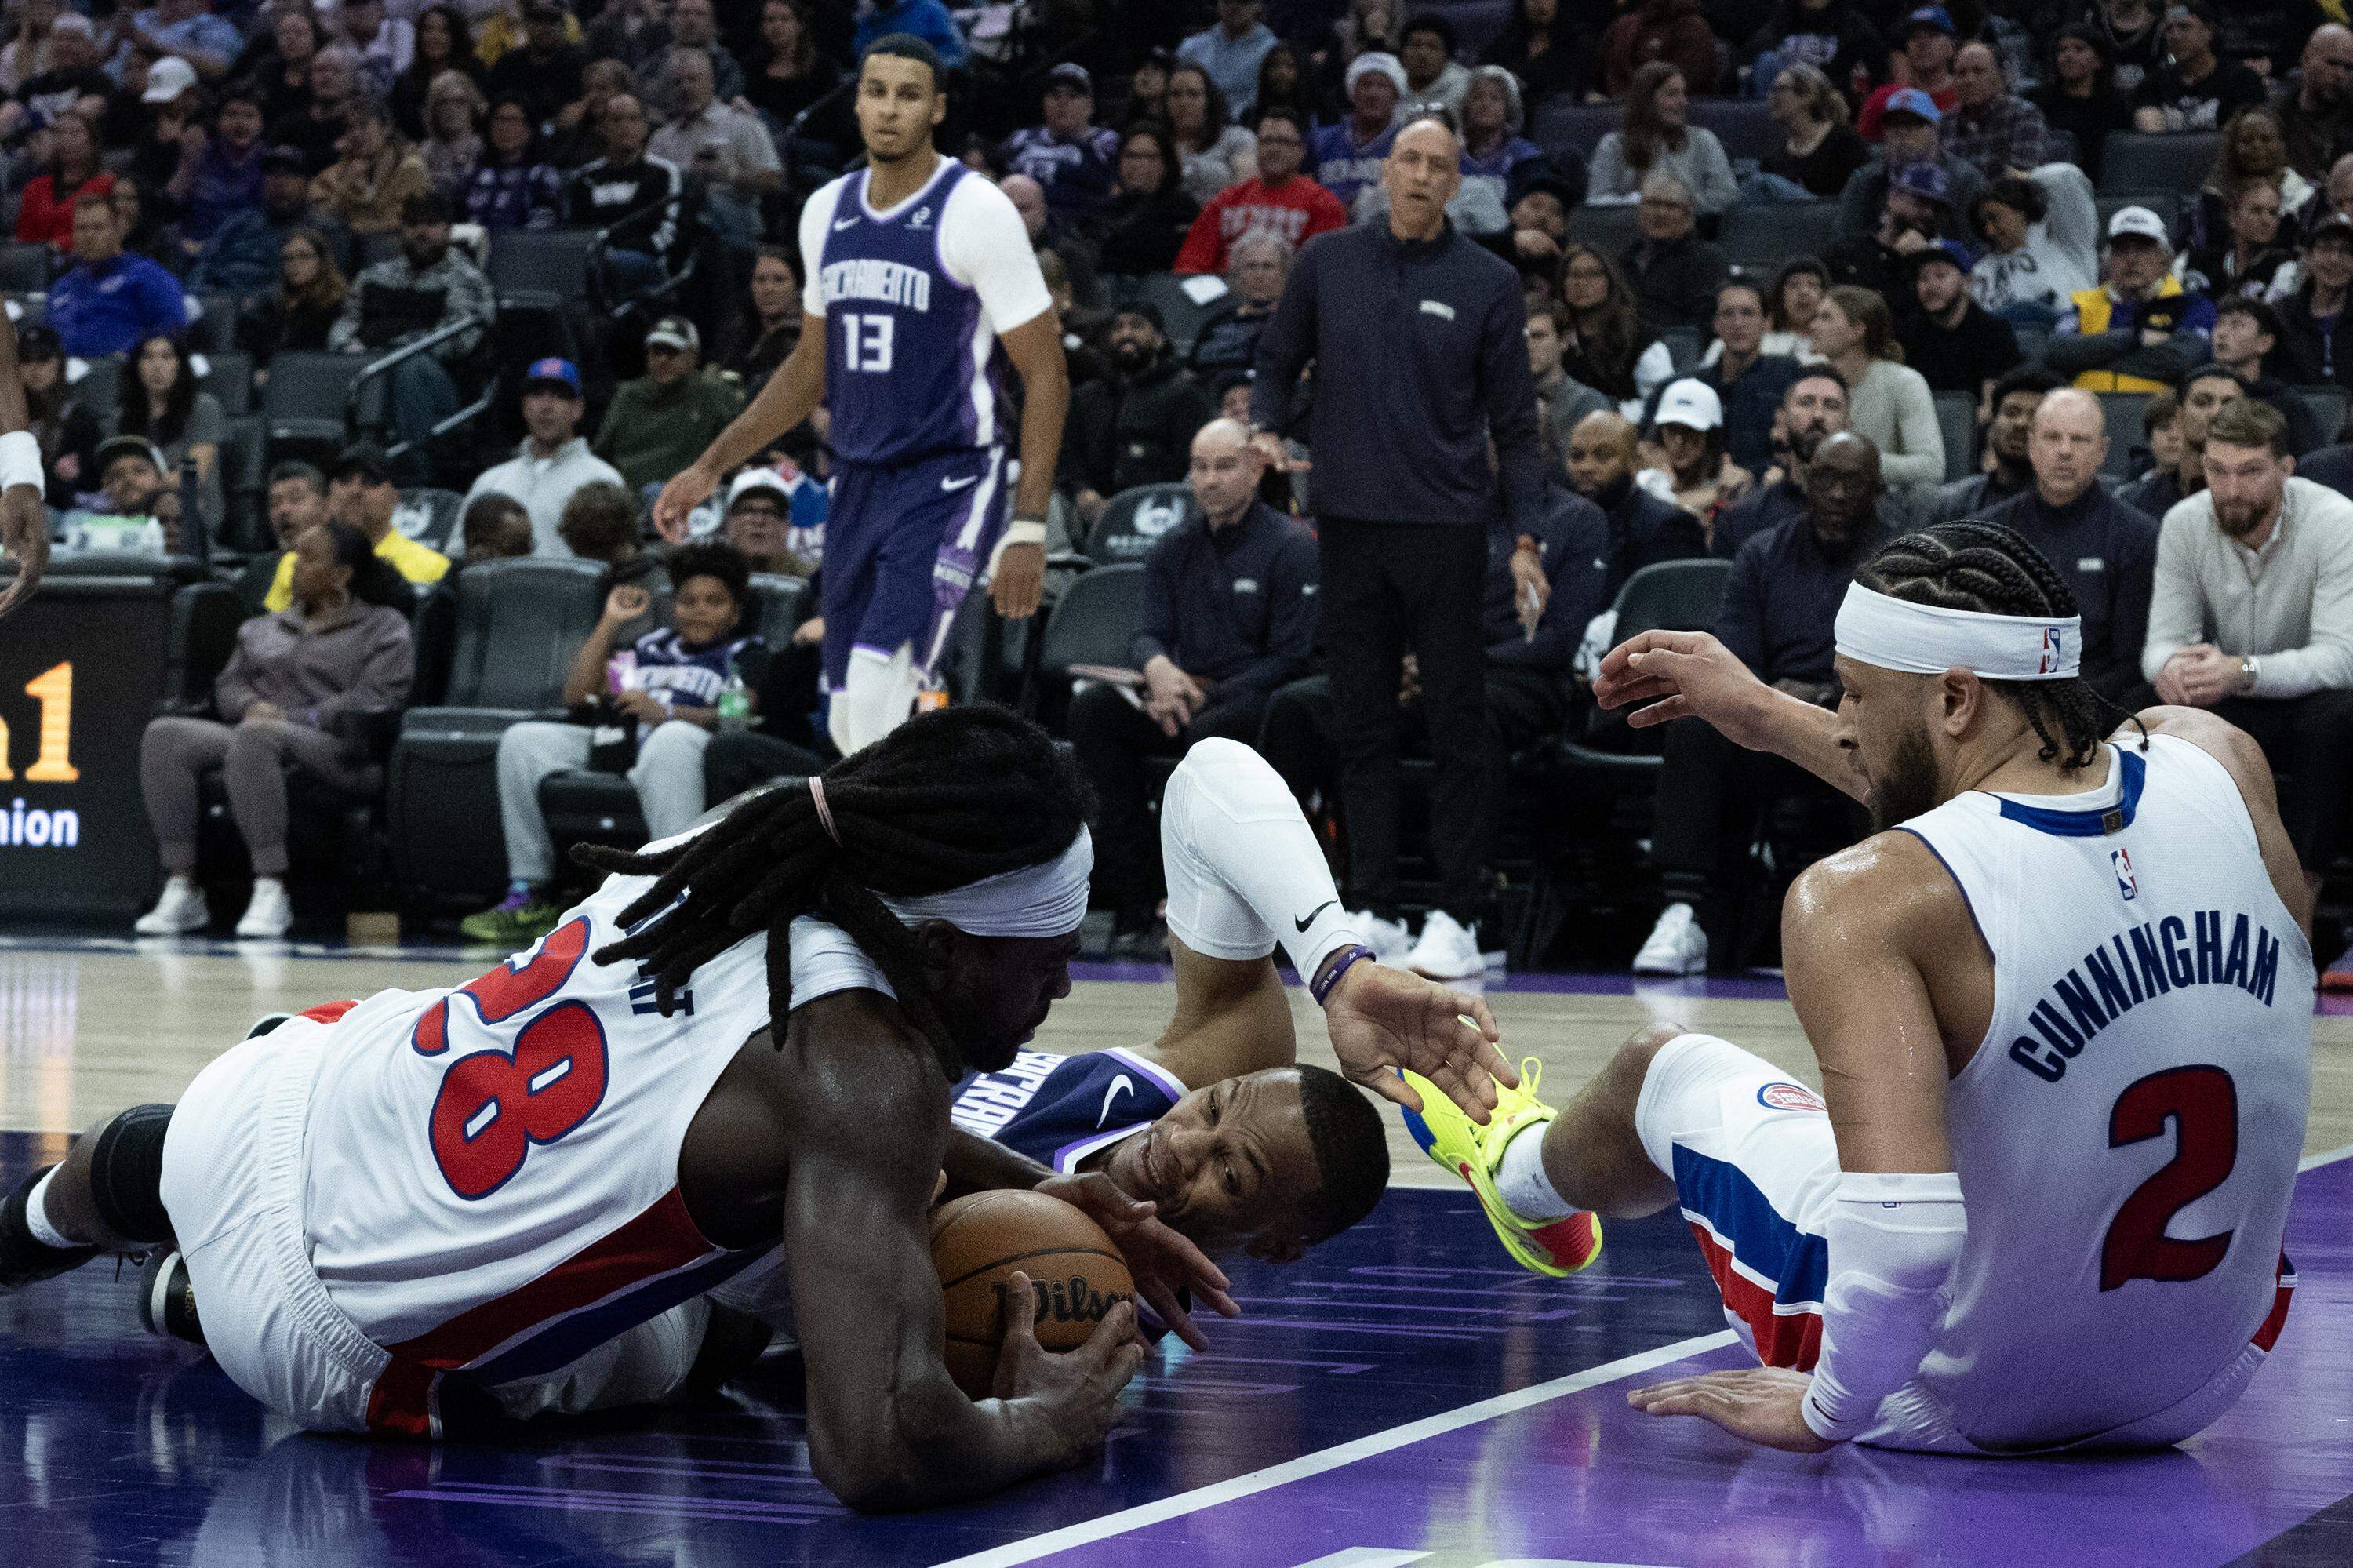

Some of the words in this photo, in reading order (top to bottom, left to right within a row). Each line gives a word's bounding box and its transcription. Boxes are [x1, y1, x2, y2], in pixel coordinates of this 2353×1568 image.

[842, 315, 894, 372] 13
[411, 915, 609, 1201] 28
[2009, 910, 2279, 1082] CUNNINGHAM
[2099, 1064, 2239, 1293] 2
